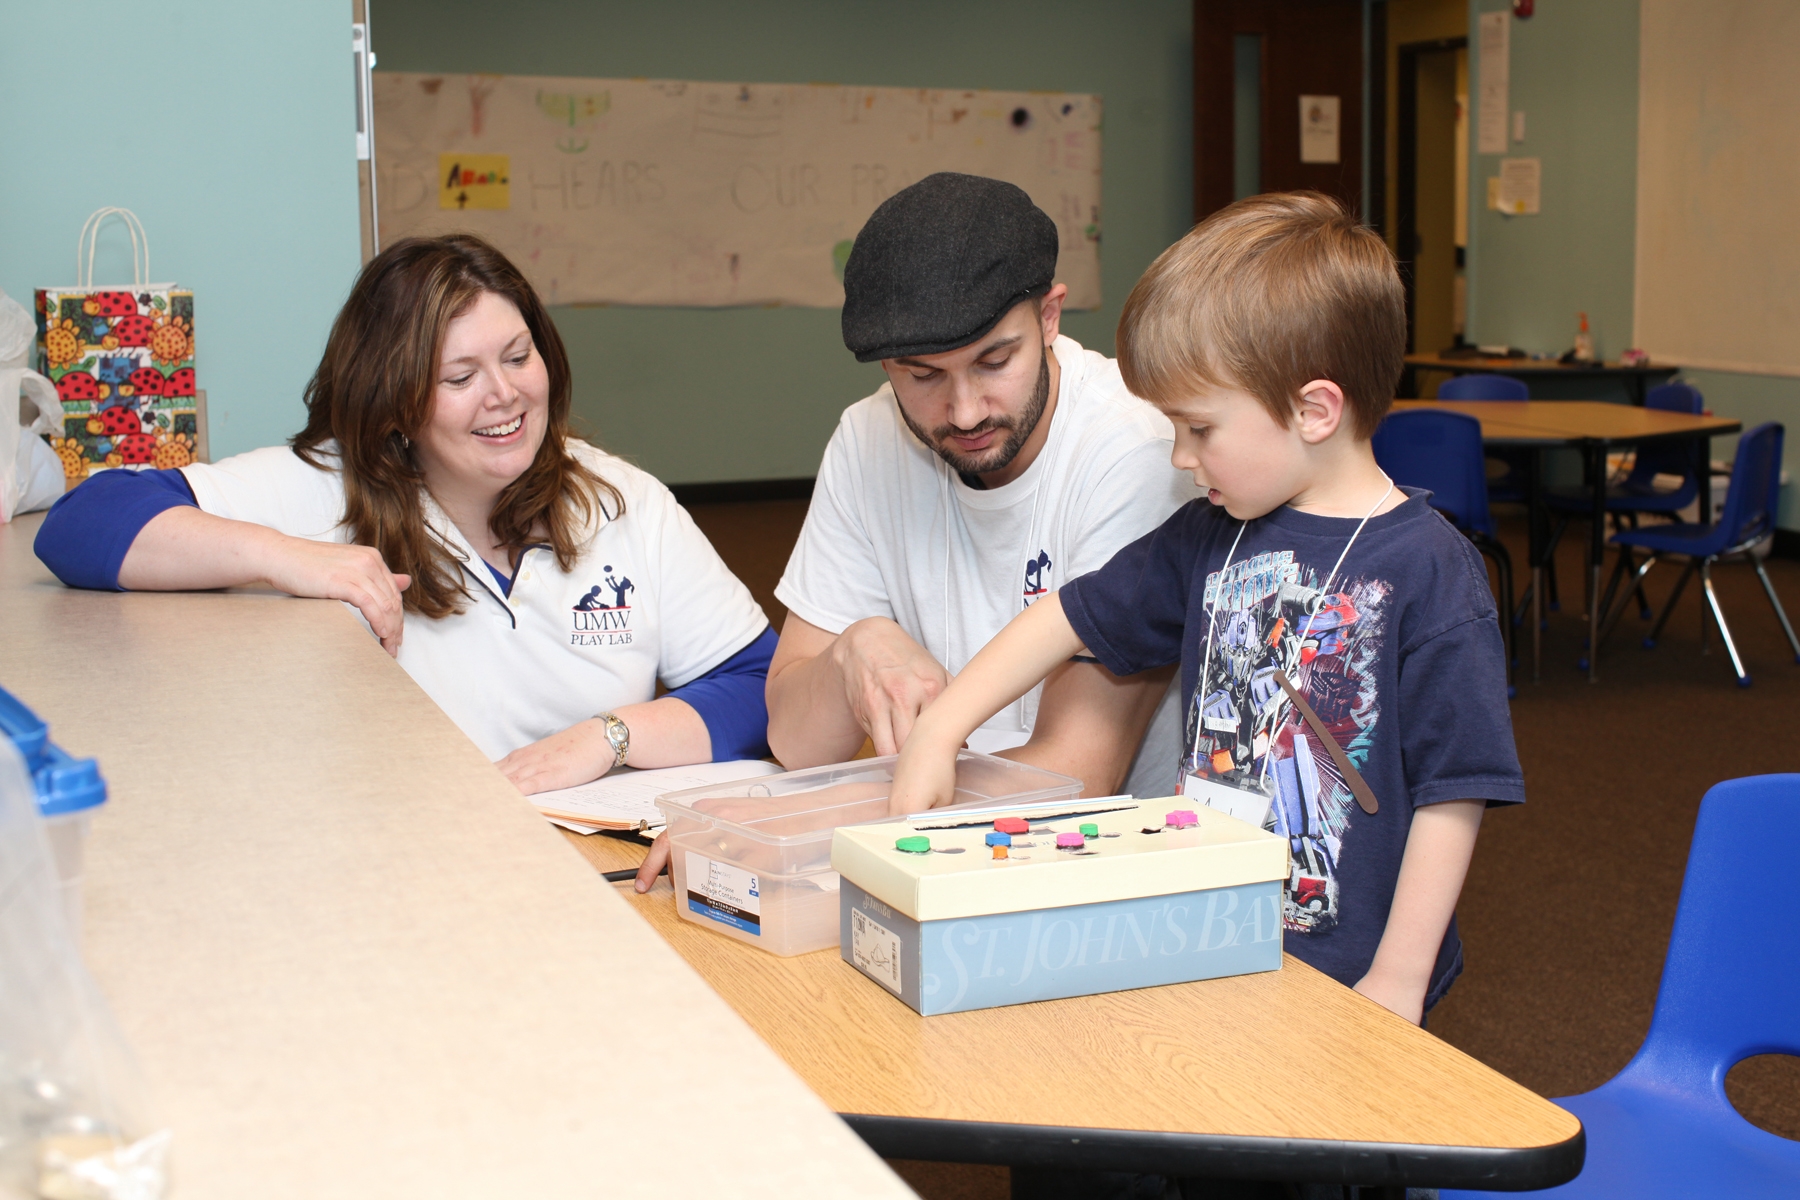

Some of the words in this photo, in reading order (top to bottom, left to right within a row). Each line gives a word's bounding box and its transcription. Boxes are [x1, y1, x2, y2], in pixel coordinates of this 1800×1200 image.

[529, 160, 667, 211] HEARS
[730, 162, 821, 214] OUR
[572, 611, 631, 631] UMW
[571, 634, 605, 646] PLAY
[609, 633, 633, 646] LAB
[751, 878, 757, 889] 5
[1009, 902, 1190, 987] JOHN'S
